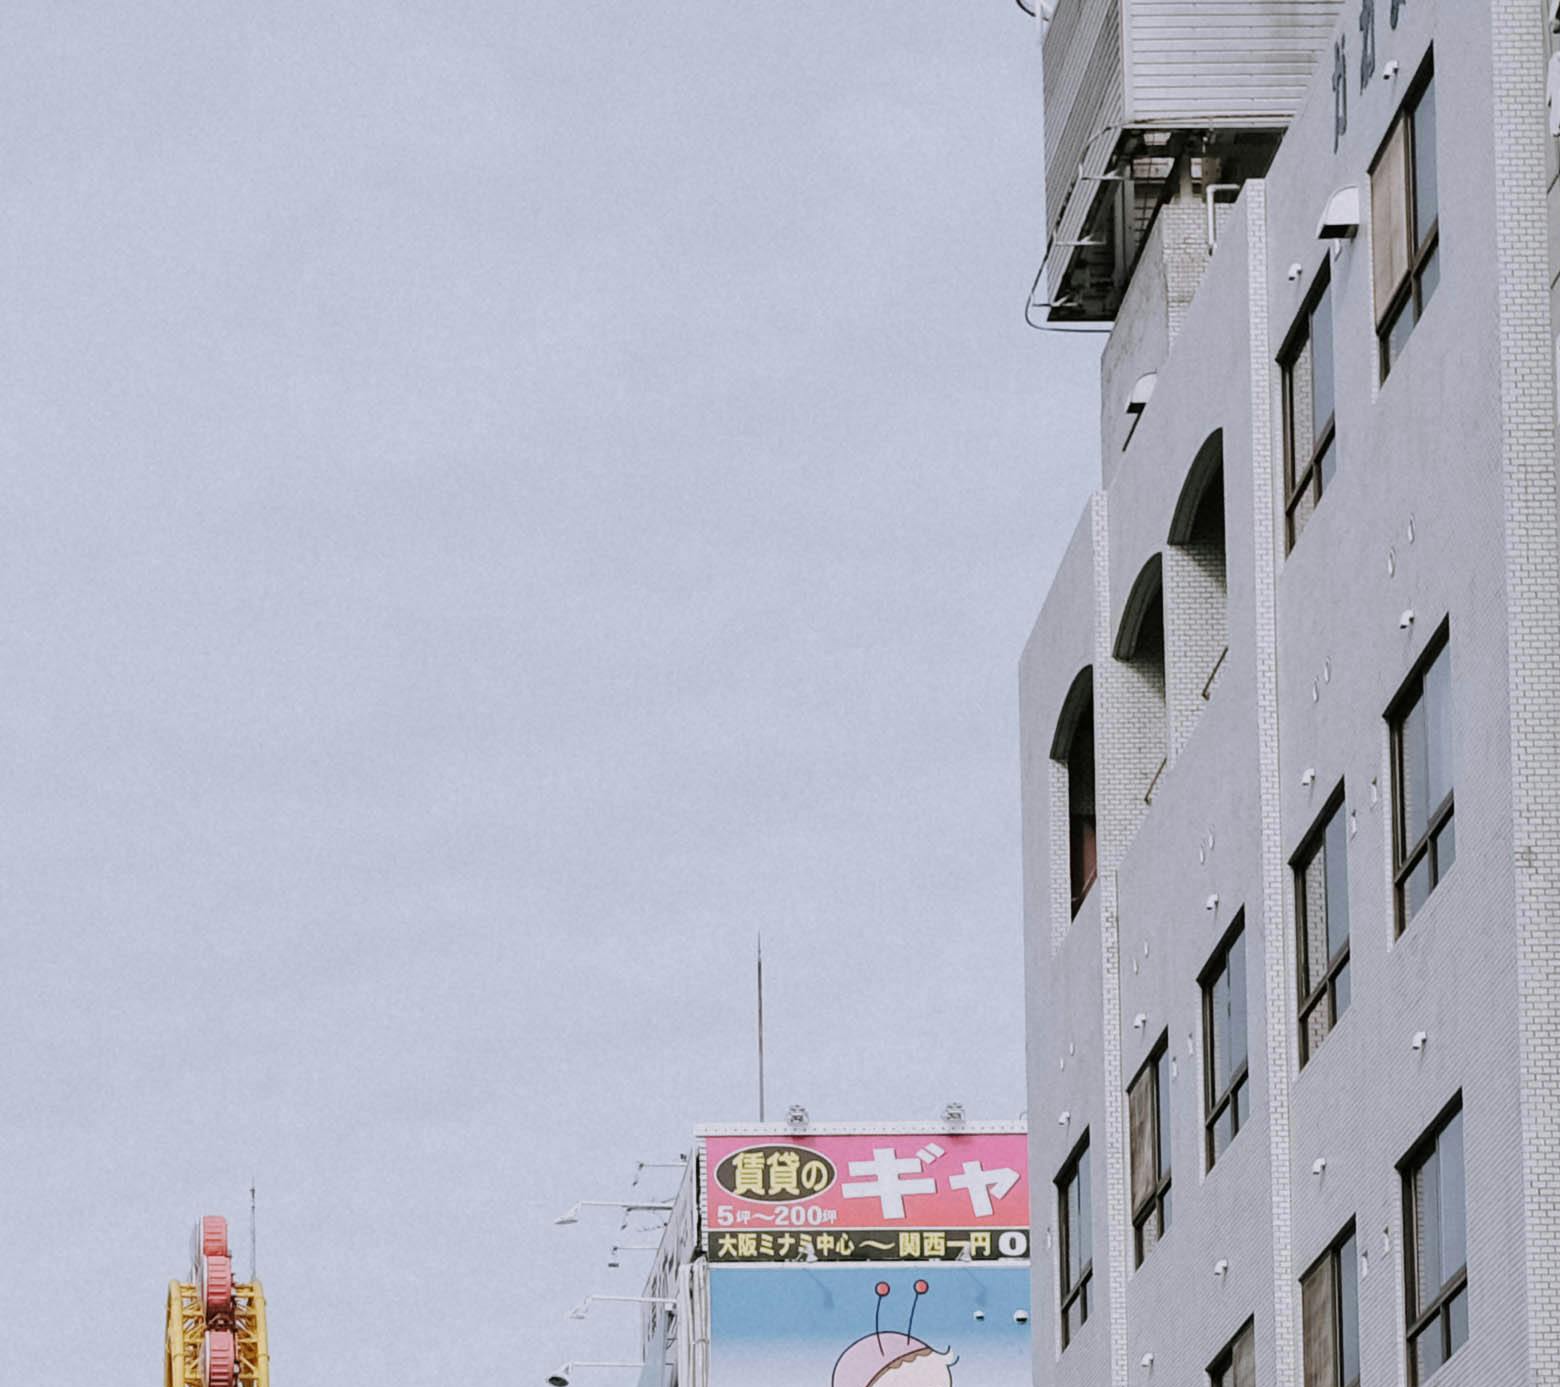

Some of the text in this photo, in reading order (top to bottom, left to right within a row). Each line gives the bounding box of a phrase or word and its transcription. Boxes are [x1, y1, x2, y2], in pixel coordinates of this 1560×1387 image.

[732, 1143, 1021, 1220] 賃貸の ギャ
